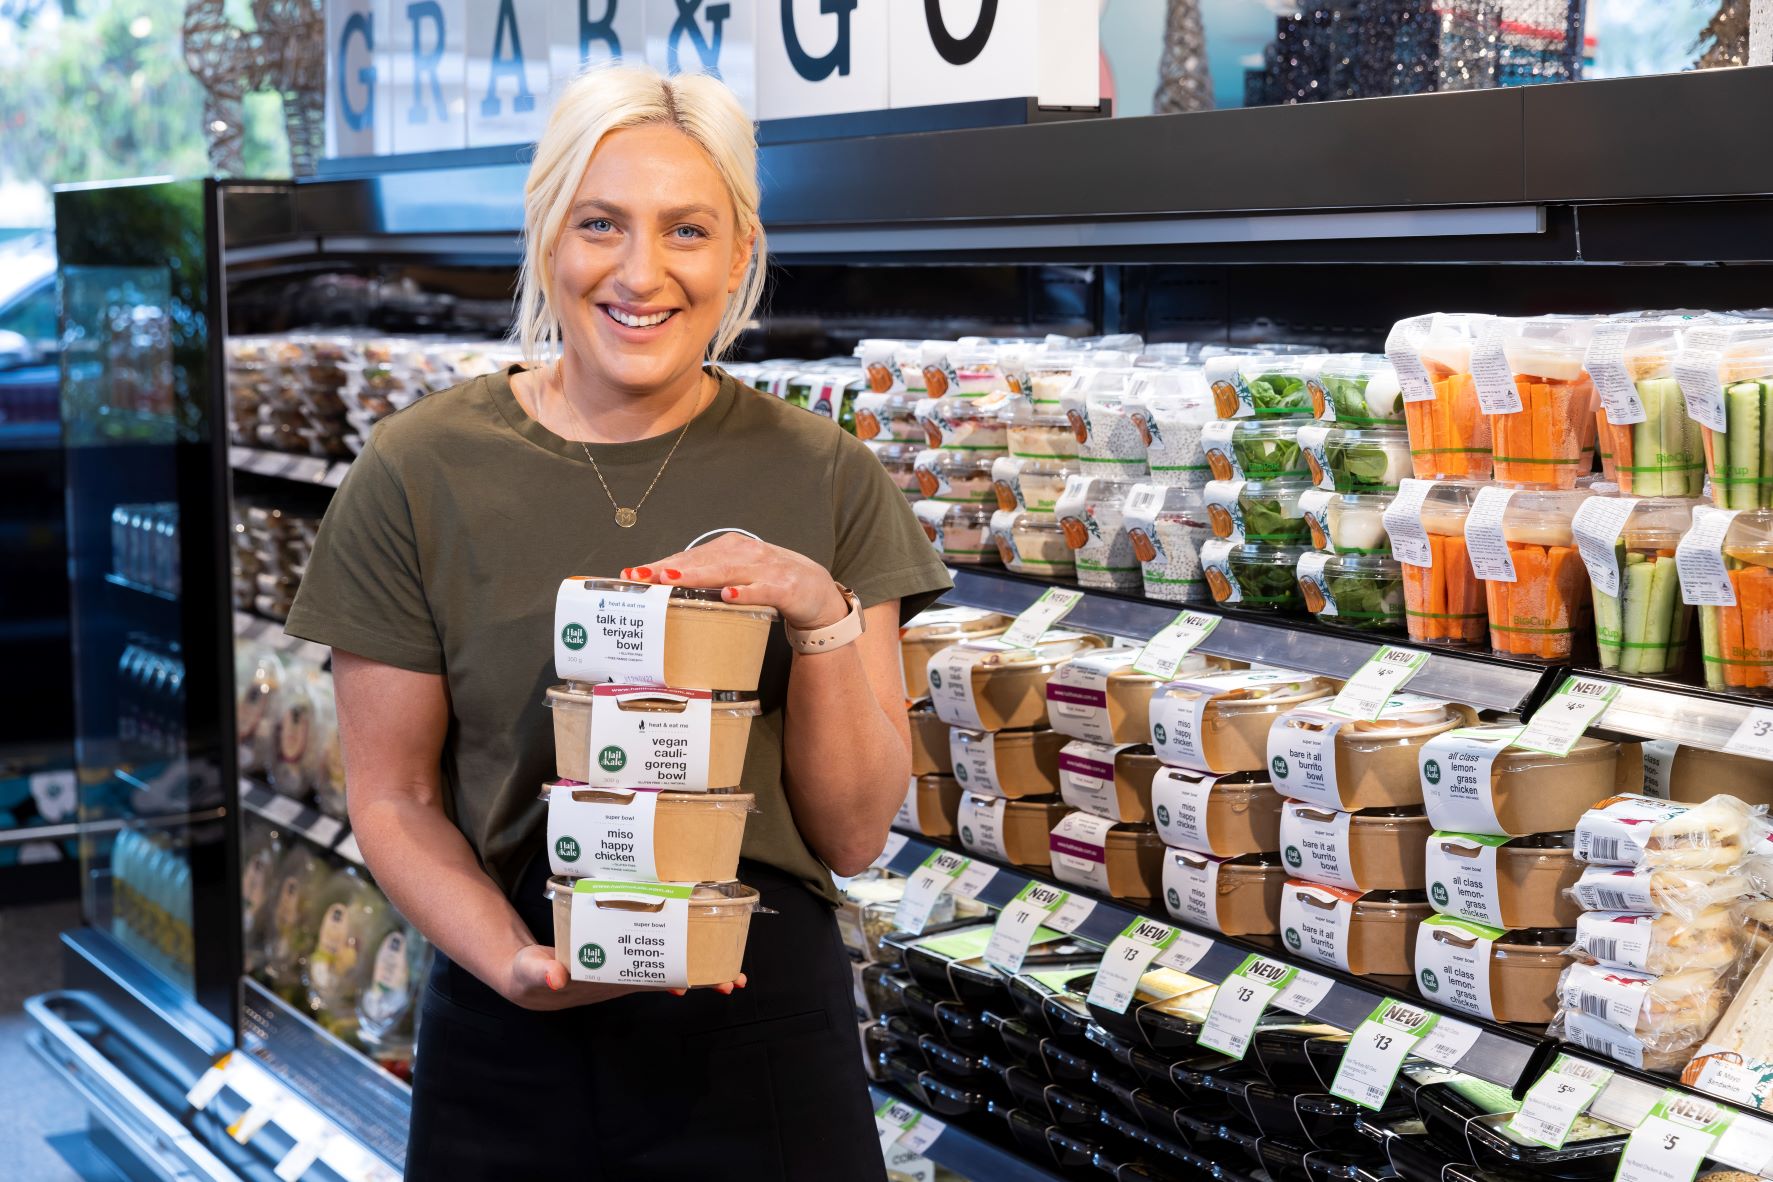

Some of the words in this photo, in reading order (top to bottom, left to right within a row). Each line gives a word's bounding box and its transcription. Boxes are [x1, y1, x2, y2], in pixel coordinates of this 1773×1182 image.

[338, 0, 622, 132] GRAB
[596, 614, 616, 624] talk
[620, 616, 626, 626] it
[630, 619, 644, 628] up
[1184, 616, 1208, 626] NEW
[1513, 616, 1552, 628] BioCup
[603, 627, 643, 640] teriyaki
[616, 640, 643, 651] bowl
[1384, 650, 1414, 662] NEW
[1572, 682, 1606, 696] NEW
[1178, 720, 1191, 728] miso
[1175, 728, 1192, 740] happy
[652, 738, 688, 748] vegan
[1173, 737, 1192, 748] chicken
[654, 748, 687, 758] cauli-
[1290, 749, 1305, 758] bare
[1306, 752, 1312, 760] it
[1314, 752, 1322, 761] all
[1448, 752, 1458, 760] all
[1459, 752, 1480, 762] class
[644, 761, 687, 772] goreng
[1298, 761, 1322, 772] burrito
[1450, 762, 1477, 772] lemon-
[657, 771, 686, 780] bowl
[1306, 772, 1324, 782] bowl
[1456, 774, 1477, 785] grass
[1450, 784, 1478, 795] chicken
[1182, 803, 1196, 812] miso
[1179, 812, 1196, 824] happy
[1176, 820, 1197, 832] chicken
[607, 829, 634, 839] miso
[601, 840, 634, 853] happy
[1302, 839, 1318, 850] bare
[1320, 842, 1325, 851] it
[1326, 844, 1335, 852] all
[595, 851, 635, 862] chicken
[935, 855, 961, 870] NEW
[1312, 851, 1336, 862] burrito
[1320, 862, 1339, 872] bowl
[1453, 876, 1462, 885] all
[1463, 878, 1483, 889] class
[1028, 887, 1059, 903] NEW
[1458, 887, 1484, 899] lemon-
[1465, 900, 1487, 910] grass
[1460, 908, 1489, 920] chicken
[1135, 923, 1168, 940] NEW
[1302, 923, 1318, 934] bare
[1319, 927, 1324, 936] it
[1326, 930, 1334, 940] all
[618, 934, 631, 944] all
[634, 936, 665, 946] class
[1311, 936, 1334, 950] burrito
[624, 946, 664, 958] lemon-
[1318, 948, 1335, 959] bowl
[633, 960, 665, 969] grass
[1248, 961, 1286, 980] NEW
[619, 969, 666, 979] chicken
[1444, 965, 1453, 975] all
[1454, 968, 1475, 980] class
[1448, 976, 1475, 990] lemon-
[1237, 986, 1254, 1002] $13
[1456, 989, 1477, 1001] grass
[1450, 996, 1480, 1010] chicken
[1384, 1005, 1427, 1027] NEW
[1373, 1033, 1392, 1050] $13
[1563, 1063, 1595, 1079] NEW
[1708, 1079, 1740, 1092] Sandwich
[1670, 1098, 1719, 1124] NEW
[1663, 1133, 1680, 1150] $5
